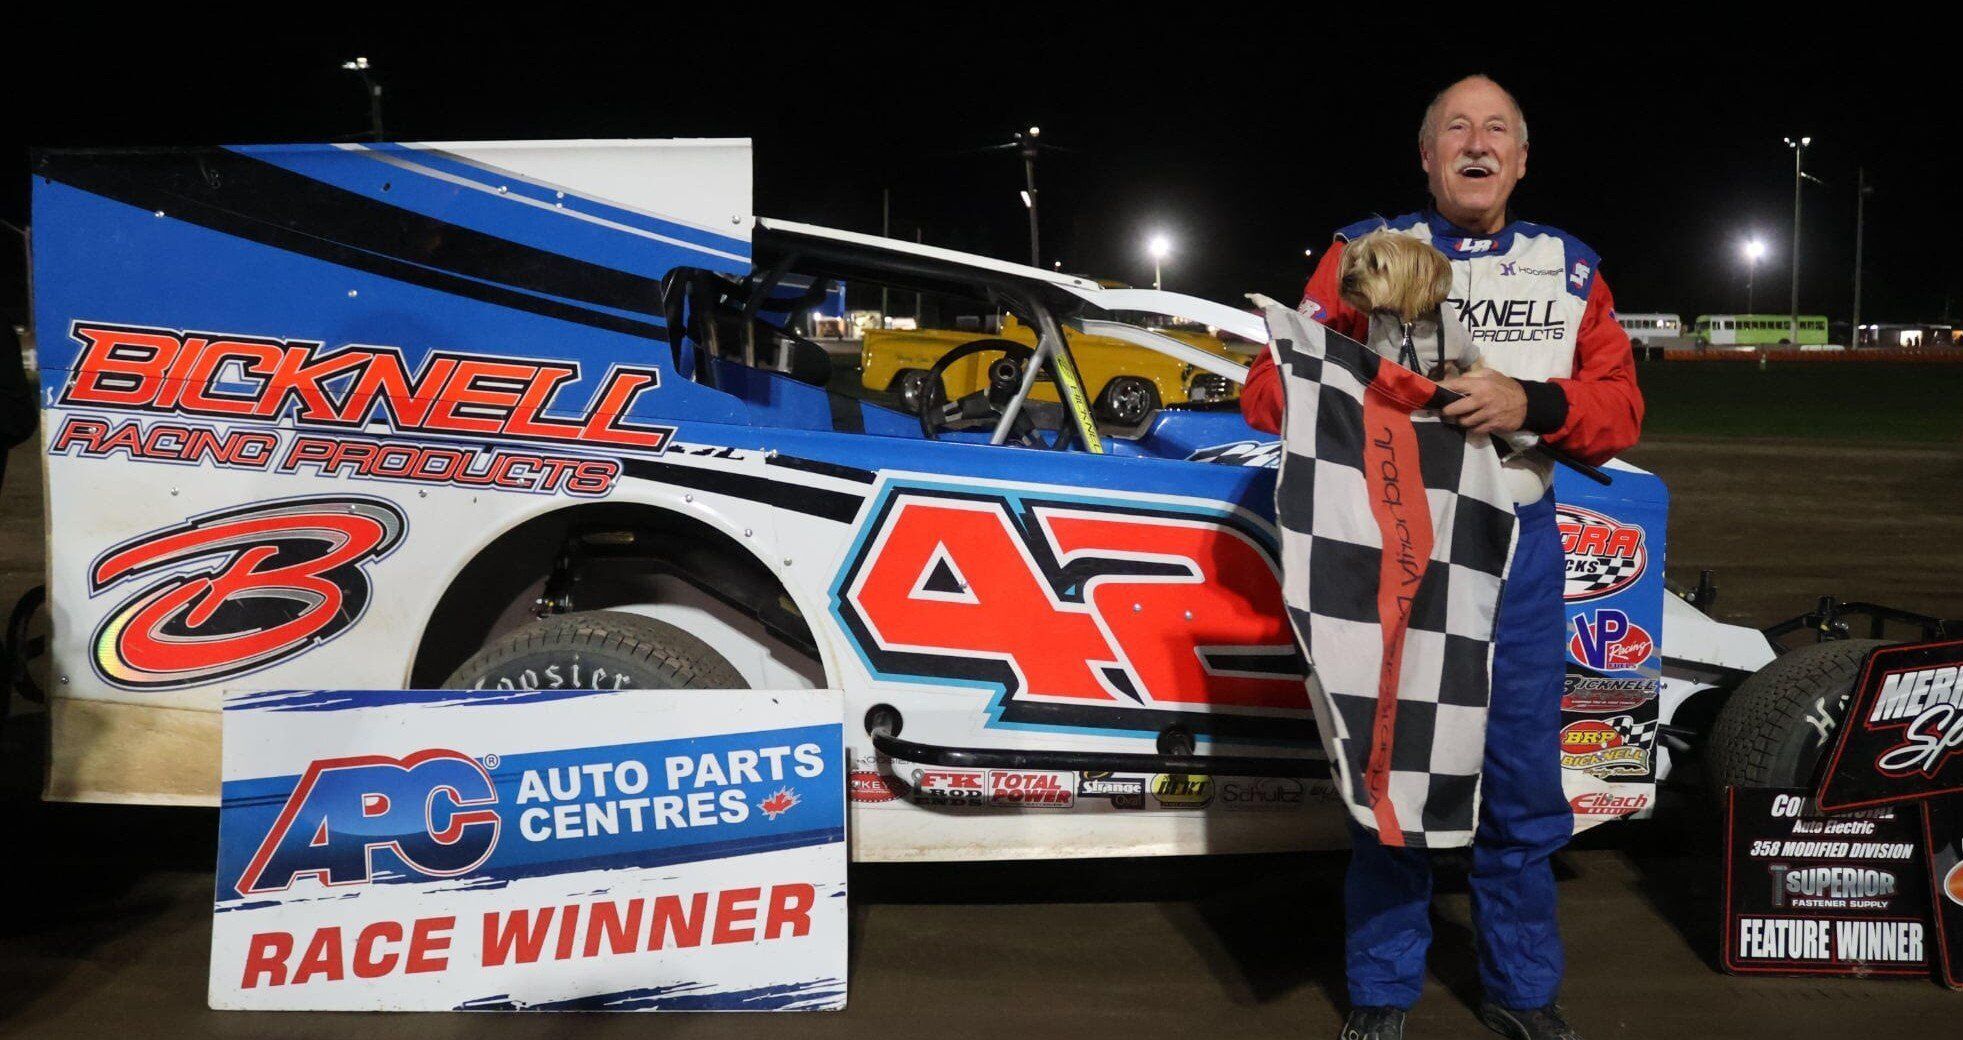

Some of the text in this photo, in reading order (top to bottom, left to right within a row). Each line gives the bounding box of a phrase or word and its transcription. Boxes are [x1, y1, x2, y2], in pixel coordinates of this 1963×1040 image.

[1446, 298, 1565, 328] KNELL
[1472, 328, 1565, 342] PRODUCTS
[62, 322, 675, 451] BICKNELL
[56, 420, 618, 493] RACING PRODUCTS
[848, 495, 1308, 716] 42
[1574, 609, 1628, 669] VP
[1608, 641, 1651, 662] Racing
[1564, 674, 1656, 695] BICKNELL
[1564, 731, 1617, 745] BRP
[1562, 748, 1643, 766] BICKNELL
[517, 742, 824, 803] AUTO PARTS
[920, 772, 983, 788] FK
[990, 772, 1063, 790] TOTAL
[929, 788, 983, 798] ROD
[992, 788, 1072, 803] POWER
[1083, 779, 1142, 794] Strange
[1571, 793, 1648, 809] Eibach
[236, 747, 500, 898] APC
[519, 795, 749, 842] CENTRES
[1825, 820, 1876, 836] Electric
[1751, 840, 1914, 859] 358 MODIFIED DIVISION
[1786, 866, 1896, 900] SUPERIOR
[1792, 899, 1889, 909] FASTENER SUPPLY
[241, 882, 815, 989] RACE WINNER
[1740, 918, 1924, 962] FEATURE WINNER
